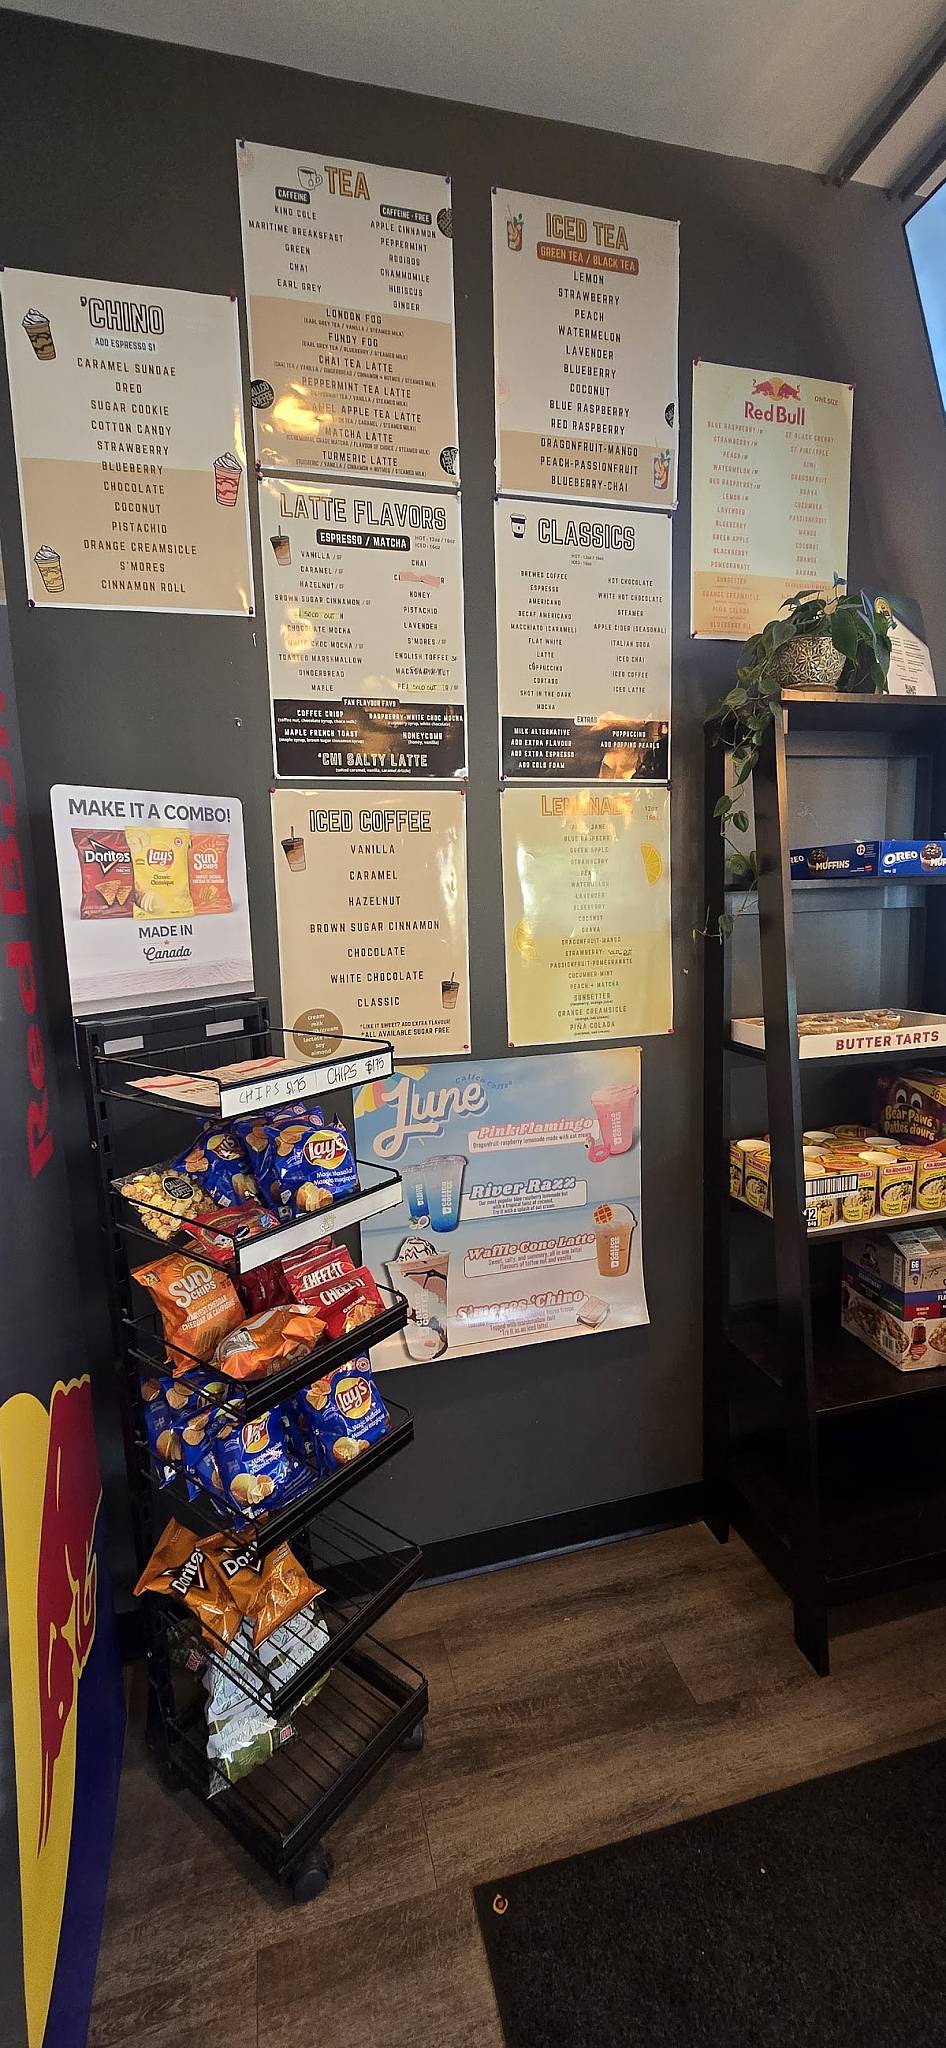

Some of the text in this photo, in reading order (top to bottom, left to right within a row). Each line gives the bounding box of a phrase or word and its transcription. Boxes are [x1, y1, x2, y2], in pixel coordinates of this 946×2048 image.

[324, 166, 370, 200] TEA
[278, 189, 308, 201] CAFFEINE
[275, 206, 317, 220] KING COLE
[249, 220, 288, 233] MARITIME
[371, 221, 436, 238] APPLE CINNAMON
[546, 212, 628, 250] ICED TEA
[285, 244, 310, 255] GREEN
[381, 238, 427, 252] PEPPERMINT
[540, 247, 636, 271] GREEN TEA BLACK TEA
[290, 263, 308, 272] CHAI
[277, 279, 322, 292] EARL GREY
[574, 272, 604, 285] LEMON
[389, 285, 423, 296] HIBISCUS
[558, 288, 620, 305] STRAWBERRY
[393, 301, 420, 311] GINGER
[326, 308, 382, 324] LONDON FOG
[575, 309, 604, 322] PEACH
[329, 333, 378, 347] FUNDY FOG
[558, 325, 621, 342] WATERMELON
[95, 337, 108, 347] ADD
[111, 339, 147, 350] ESPRESSO
[566, 345, 614, 360] LAVENDER
[77, 358, 176, 376] CARAMEL SUNDAE
[563, 364, 616, 379] BLUEBERRY
[116, 382, 142, 393] OREO
[302, 377, 411, 398] PEPPERMINT TEA LATTE
[570, 383, 610, 397] COCONUT
[91, 400, 169, 416] SUGAR COOKIE
[549, 400, 630, 417] BLUE RASPBERRY
[745, 401, 805, 425] Red Bull
[91, 420, 172, 436] COTTON CANDY
[551, 418, 625, 435] RED RASPBERRY
[97, 441, 169, 455] STRAWBERRY
[541, 437, 638, 457] DRAGONFRUIT-MANGO
[322, 451, 397, 466] TURMERIC LATTE
[540, 456, 638, 475] PEACH-PASSIONFRUIT
[102, 461, 163, 475] BLUEBERRY
[103, 481, 165, 494] CHOCOLATE
[551, 475, 628, 491] BLUEBERRY-CHAI
[114, 502, 161, 513] COCONUT
[280, 493, 446, 530] LATTE FLAVORS
[112, 522, 167, 533] PISTACHIO
[538, 518, 635, 550] CLASSICS
[84, 539, 197, 554] ORANGE CREAMSICLE
[320, 532, 406, 548] ESPRESSO MATCHA
[301, 551, 330, 560] VANILLA
[120, 561, 165, 572] S'MORES
[301, 566, 332, 574] CARAMEL
[101, 580, 185, 592] CINNAMON ROLL
[300, 581, 334, 589] HAZELNUT
[529, 598, 561, 606] AMERICANO
[404, 622, 438, 630] LAVENDER
[299, 670, 344, 678] GINGERBREAD
[403, 732, 442, 740] HONEYCOMB
[531, 728, 570, 736] ALTERNATIVE
[347, 753, 386, 766] SALTY
[390, 754, 427, 767] LATTE
[69, 798, 231, 823] MAKE IT A COMBO!
[310, 810, 431, 833] ICED COFFEE
[85, 850, 130, 863] Doritos
[351, 845, 395, 854] VANILLA
[816, 860, 850, 870] MUFFINS
[884, 851, 918, 865] OREO
[350, 871, 398, 881] CARAMEL
[349, 896, 401, 906] HAZELNUT
[139, 925, 192, 938] MADE IN
[310, 921, 439, 933] BROWN SUGAR CINNAMON
[144, 946, 192, 960] Canada
[348, 947, 405, 957] CHOCOLATE
[331, 971, 424, 984] WHITE CHOCOLATE
[358, 997, 400, 1008] CLASSIC
[379, 1029, 412, 1037] AVAILABLE
[835, 1031, 939, 1050] BUTTER TARTS
[327, 1064, 357, 1085] CHIPS
[240, 1083, 279, 1104] CHIPS
[373, 1077, 485, 1158] June
[885, 1105, 933, 1127] Bear Paws
[478, 1118, 593, 1139] Pink Flamingo
[885, 1120, 908, 1135] Pattes
[469, 1177, 576, 1200] River Razz
[468, 1233, 595, 1260] Waffle Cone Latte
[168, 1270, 213, 1309] Sun
[191, 1281, 216, 1299] CHIPS
[172, 1548, 203, 1594] Dorito
